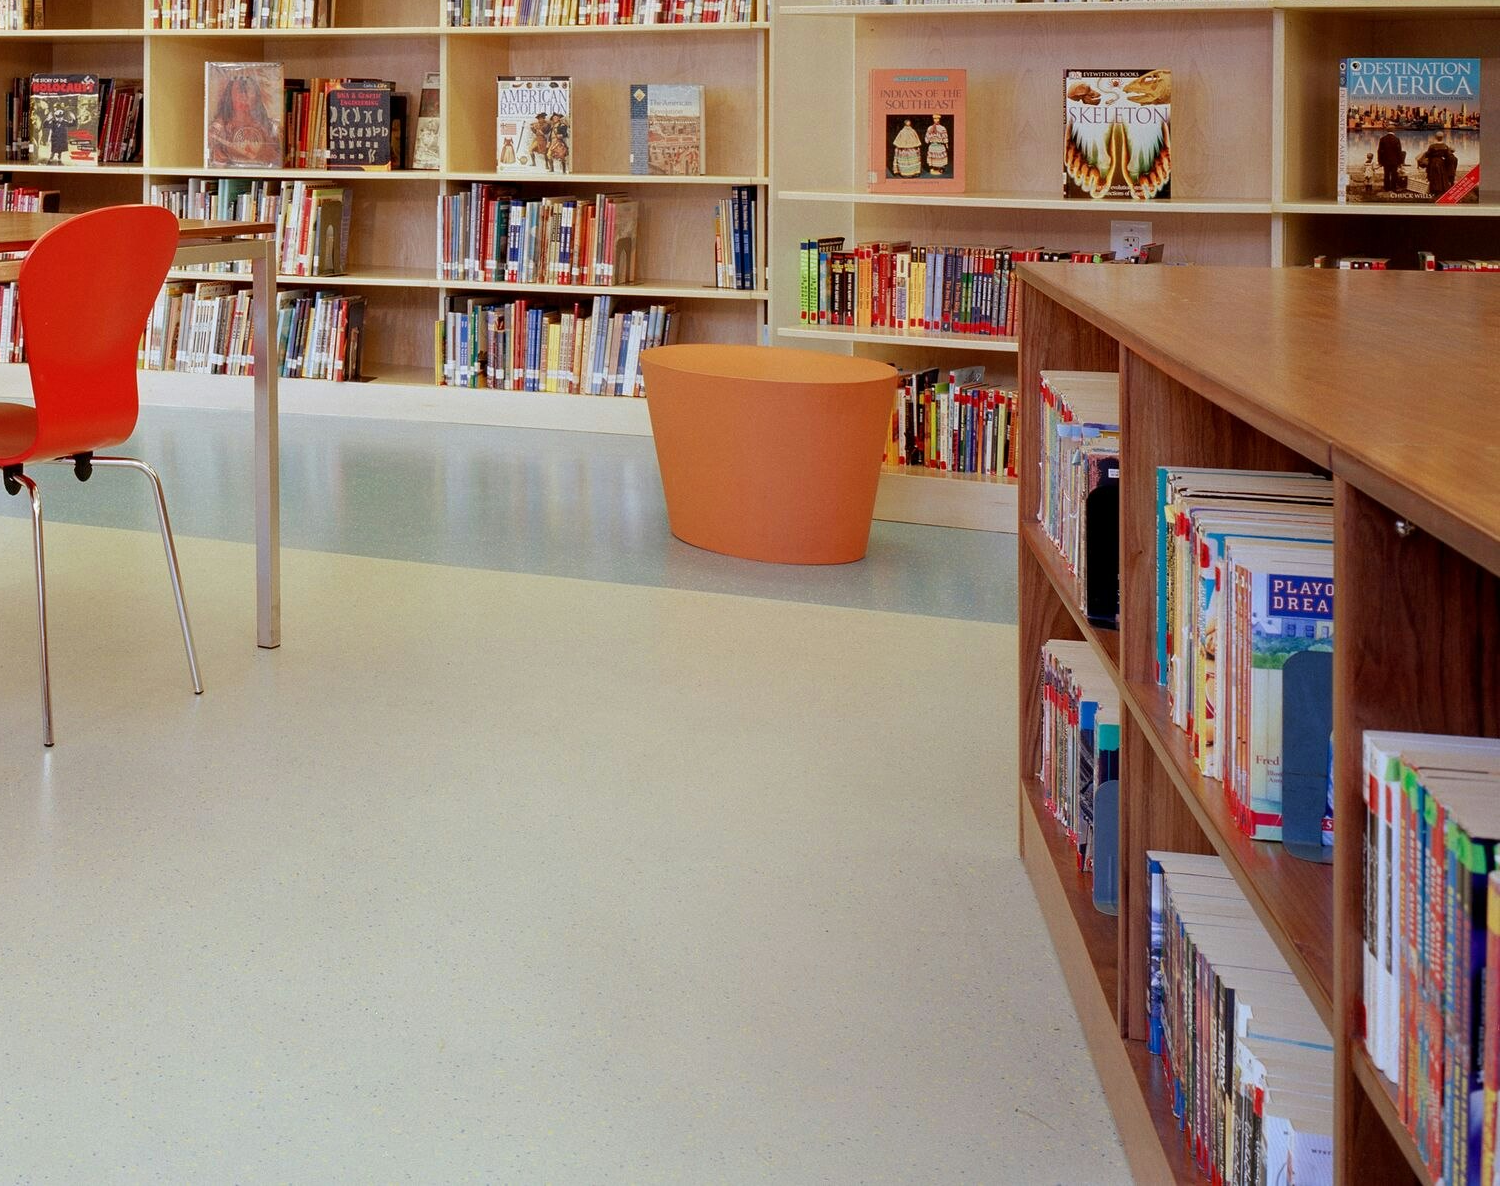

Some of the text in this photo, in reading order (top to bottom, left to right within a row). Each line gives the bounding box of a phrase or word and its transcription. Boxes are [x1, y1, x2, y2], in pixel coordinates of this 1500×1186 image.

[1363, 62, 1471, 75] DESTINATION
[1351, 76, 1474, 95] AMERICA
[500, 90, 567, 103] AMERICAN
[880, 89, 962, 98] INDIANS OF THE
[500, 103, 567, 115] REVOLUTION
[885, 99, 956, 109] SOUTHEAST
[1068, 107, 1170, 124] SKELETON
[1273, 580, 1334, 596] PLAYO
[1273, 596, 1329, 613] DREA
[1256, 755, 1280, 766] Fred
[1446, 885, 1454, 1010] BRUCE COVILLE
